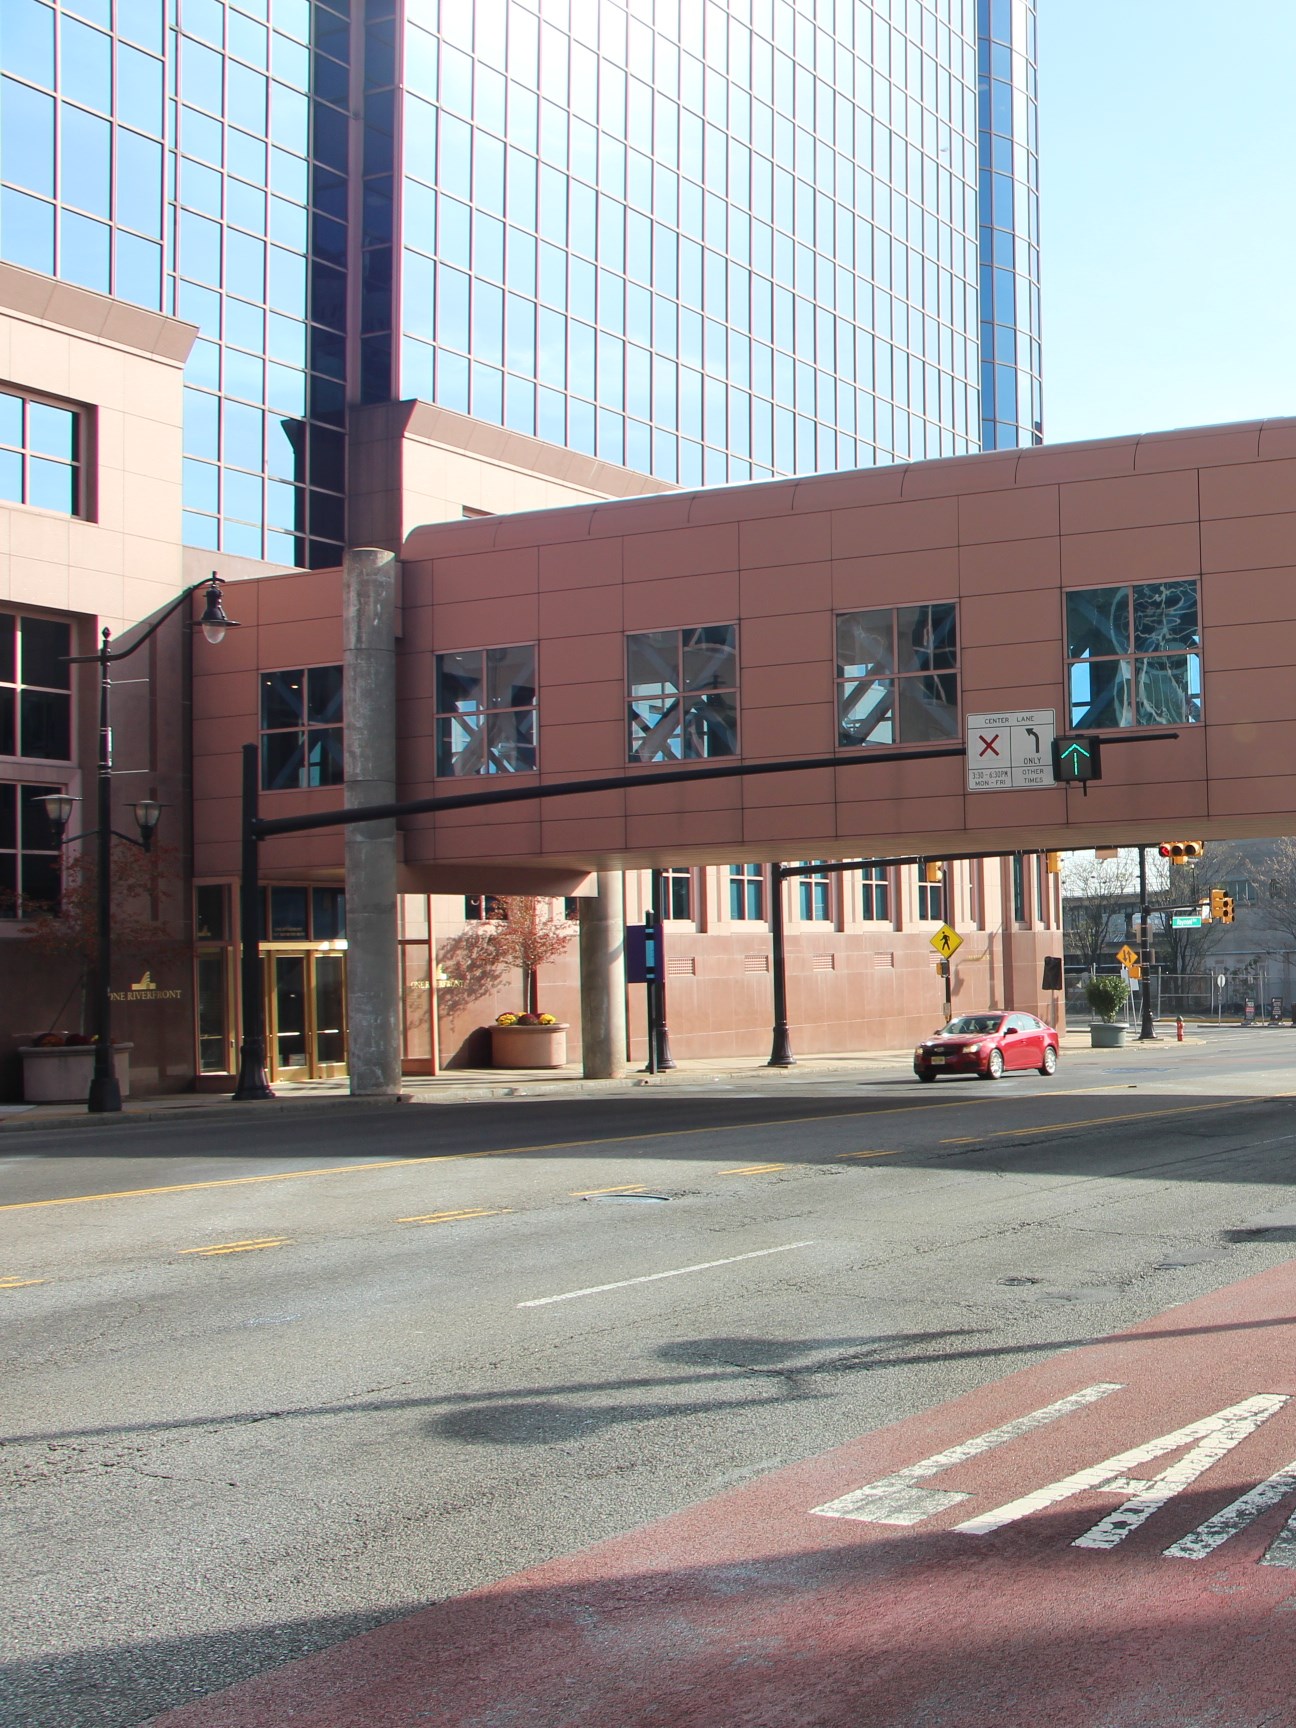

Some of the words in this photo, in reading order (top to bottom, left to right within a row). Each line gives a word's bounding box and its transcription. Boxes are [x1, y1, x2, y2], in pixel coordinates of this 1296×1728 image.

[1016, 715, 1035, 723] LANE
[1023, 757, 1042, 765] ONLY
[127, 990, 182, 1001] RIVERFRONT
